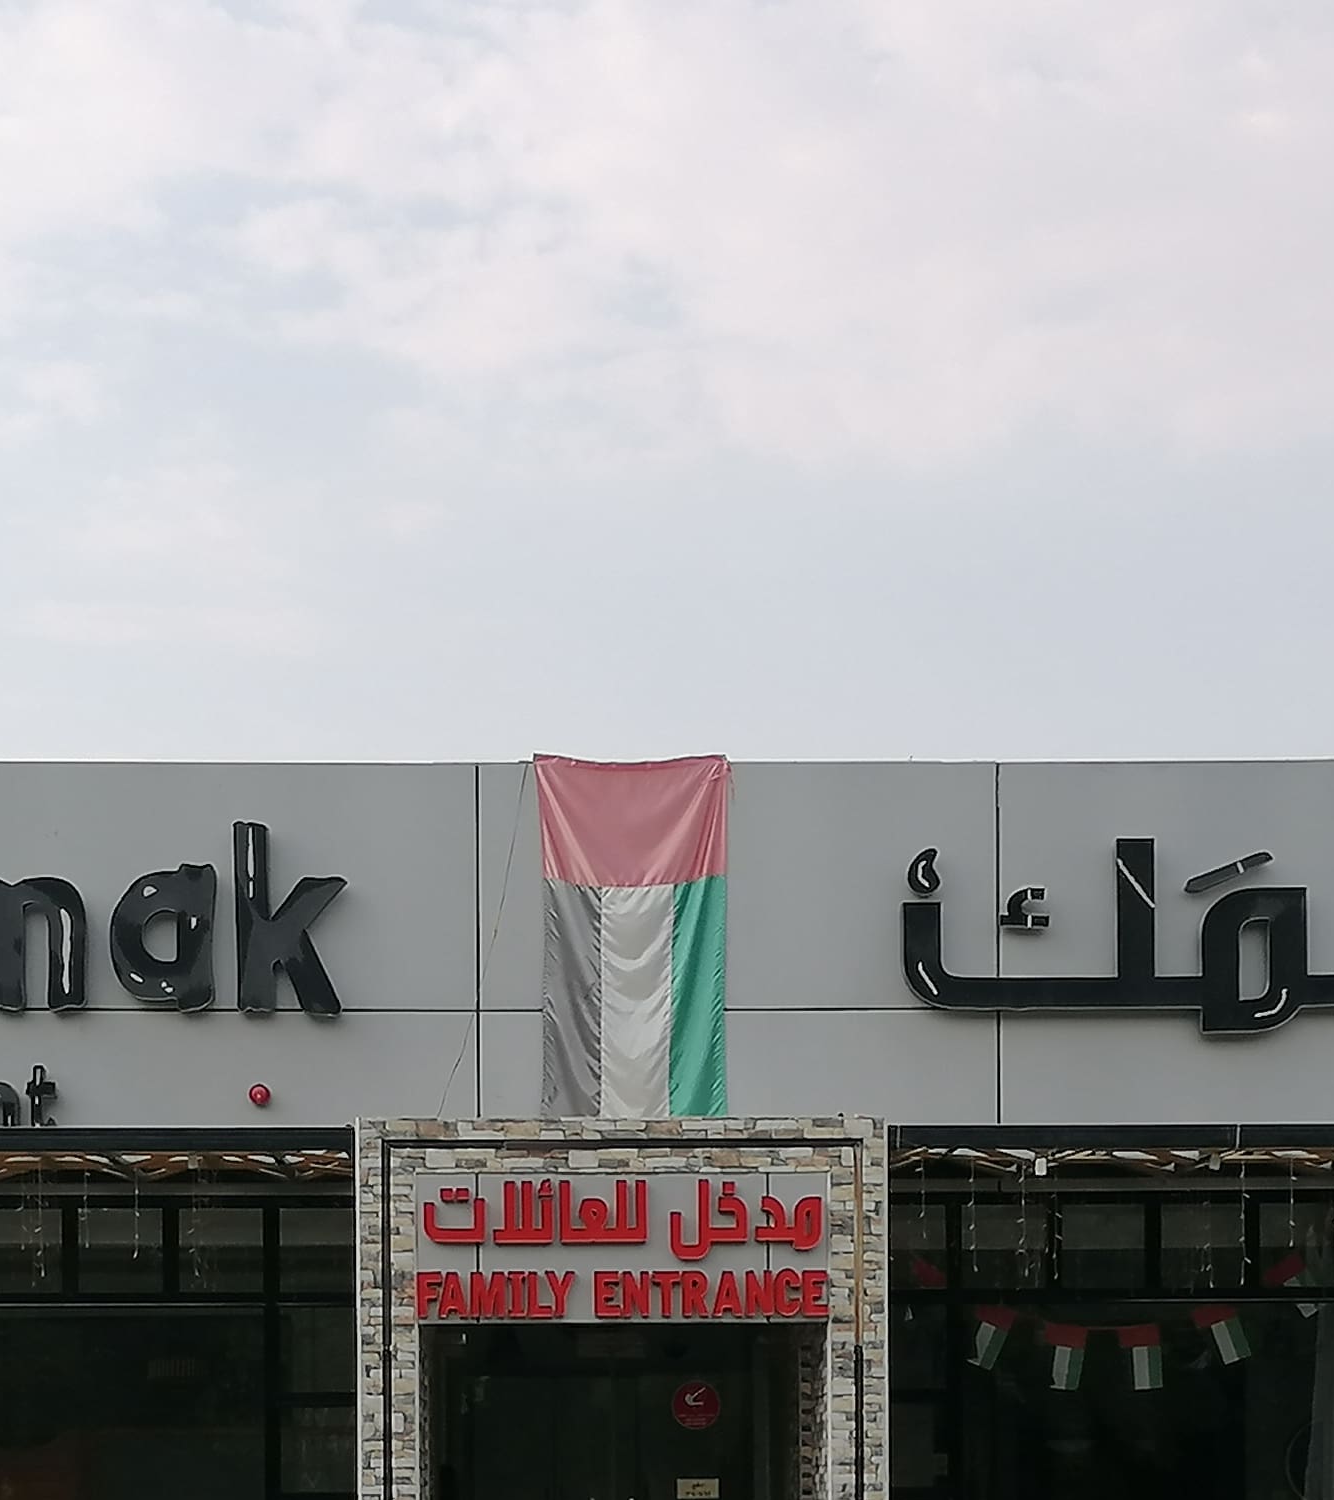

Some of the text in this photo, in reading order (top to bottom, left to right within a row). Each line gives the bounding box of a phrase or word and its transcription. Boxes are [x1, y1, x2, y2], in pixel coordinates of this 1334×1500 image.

[423, 1178, 823, 1261] مدخل للعائلات
[416, 1268, 830, 1319] FAMILY ENTRANCE
